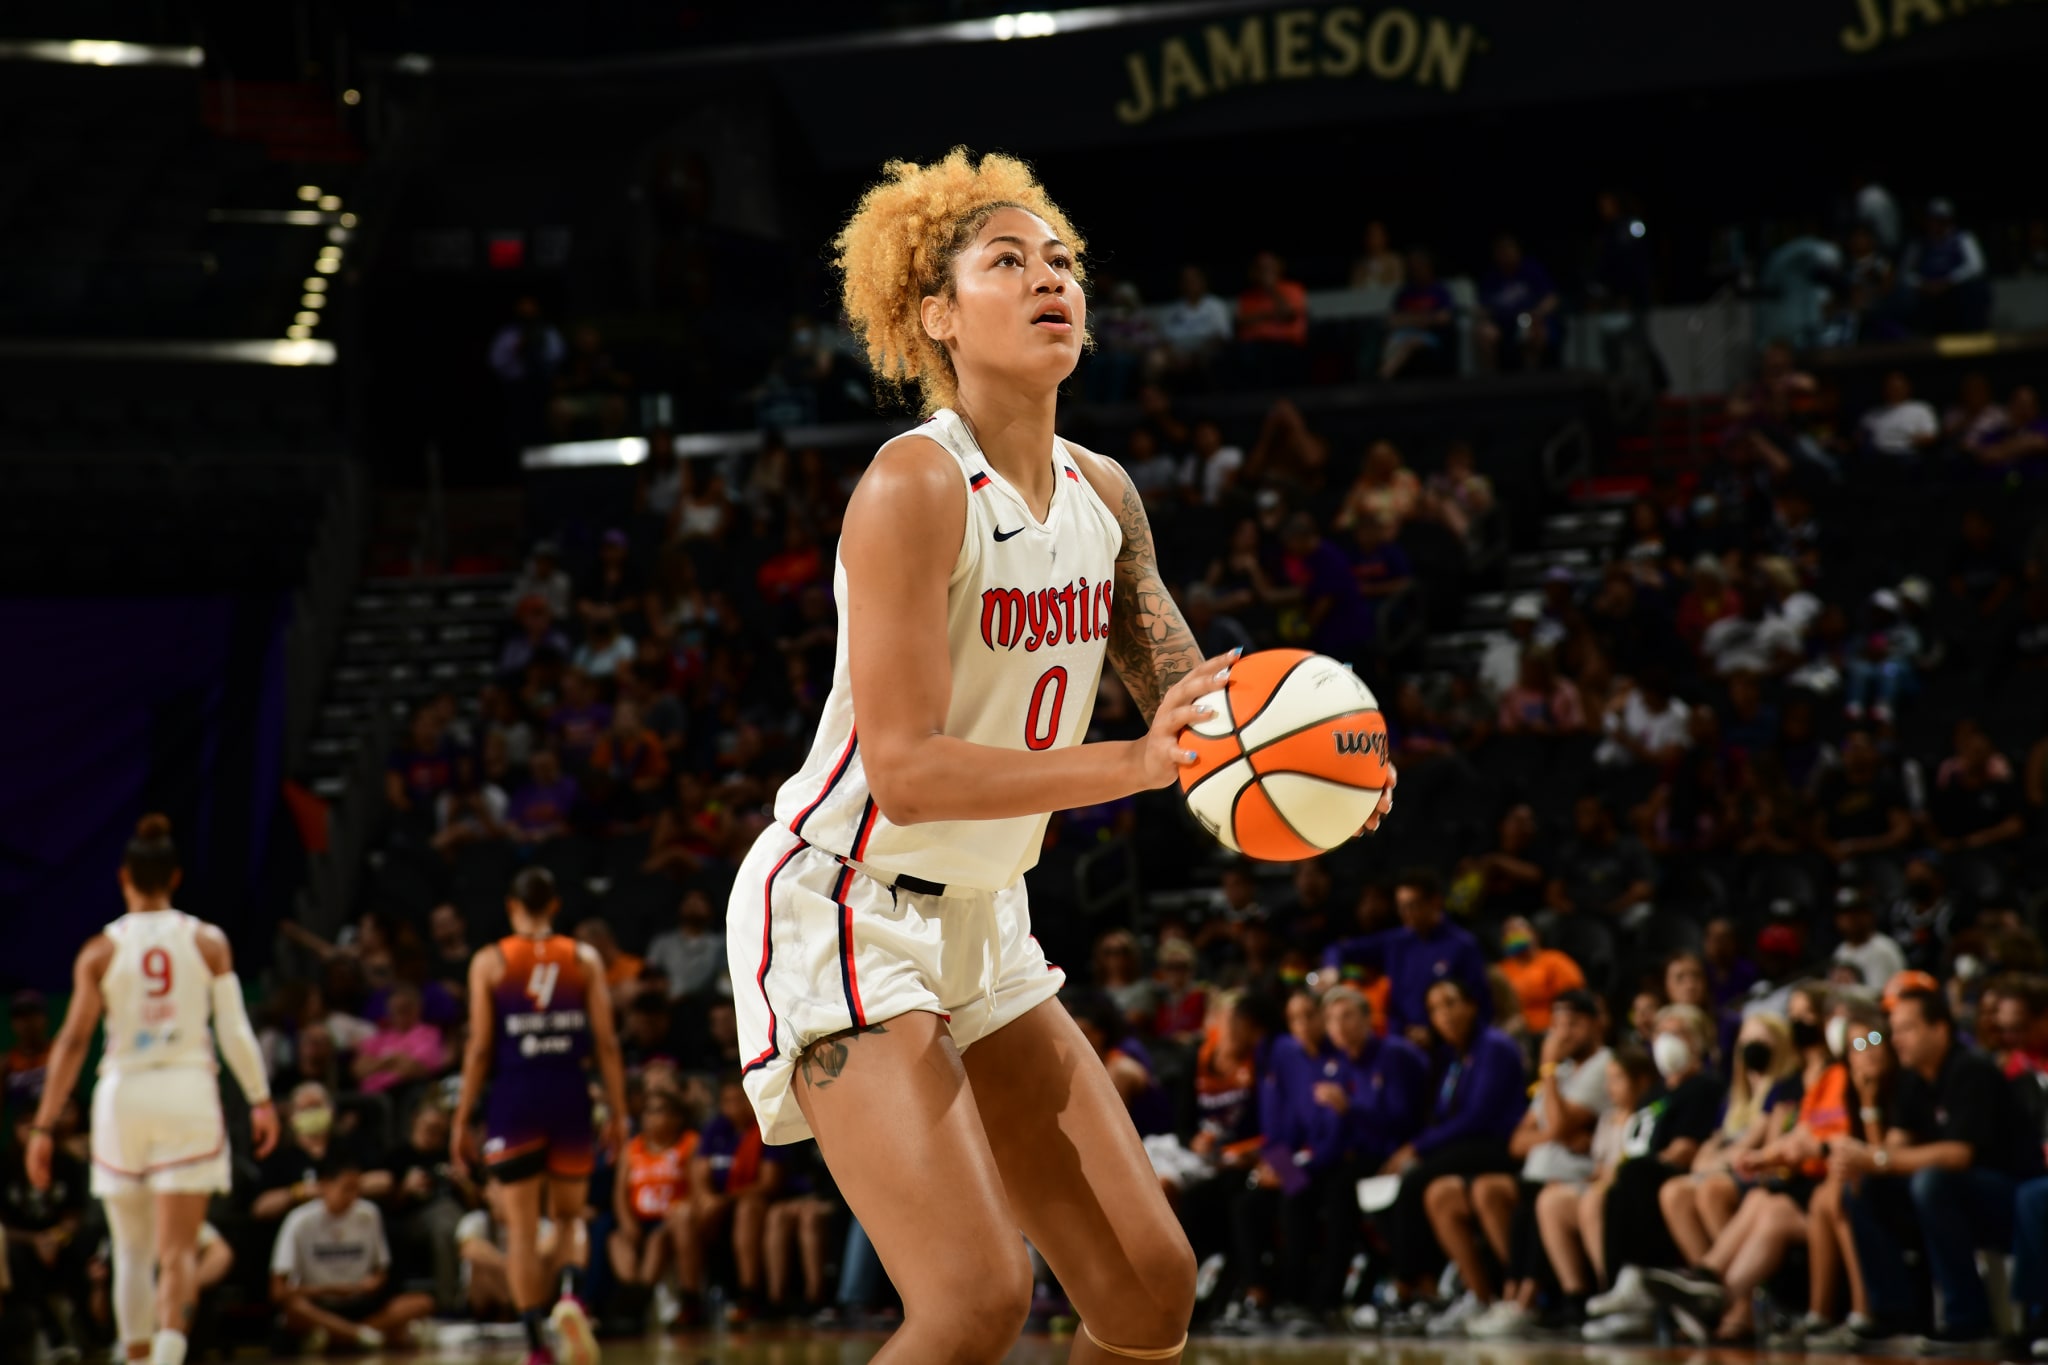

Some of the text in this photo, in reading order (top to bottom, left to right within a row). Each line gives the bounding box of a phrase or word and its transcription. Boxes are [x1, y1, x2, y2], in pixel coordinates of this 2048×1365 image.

[1115, 6, 1476, 126] JAMESON
[1025, 665, 1068, 751] 0
[141, 946, 173, 999] 9
[526, 961, 559, 1011] 4
